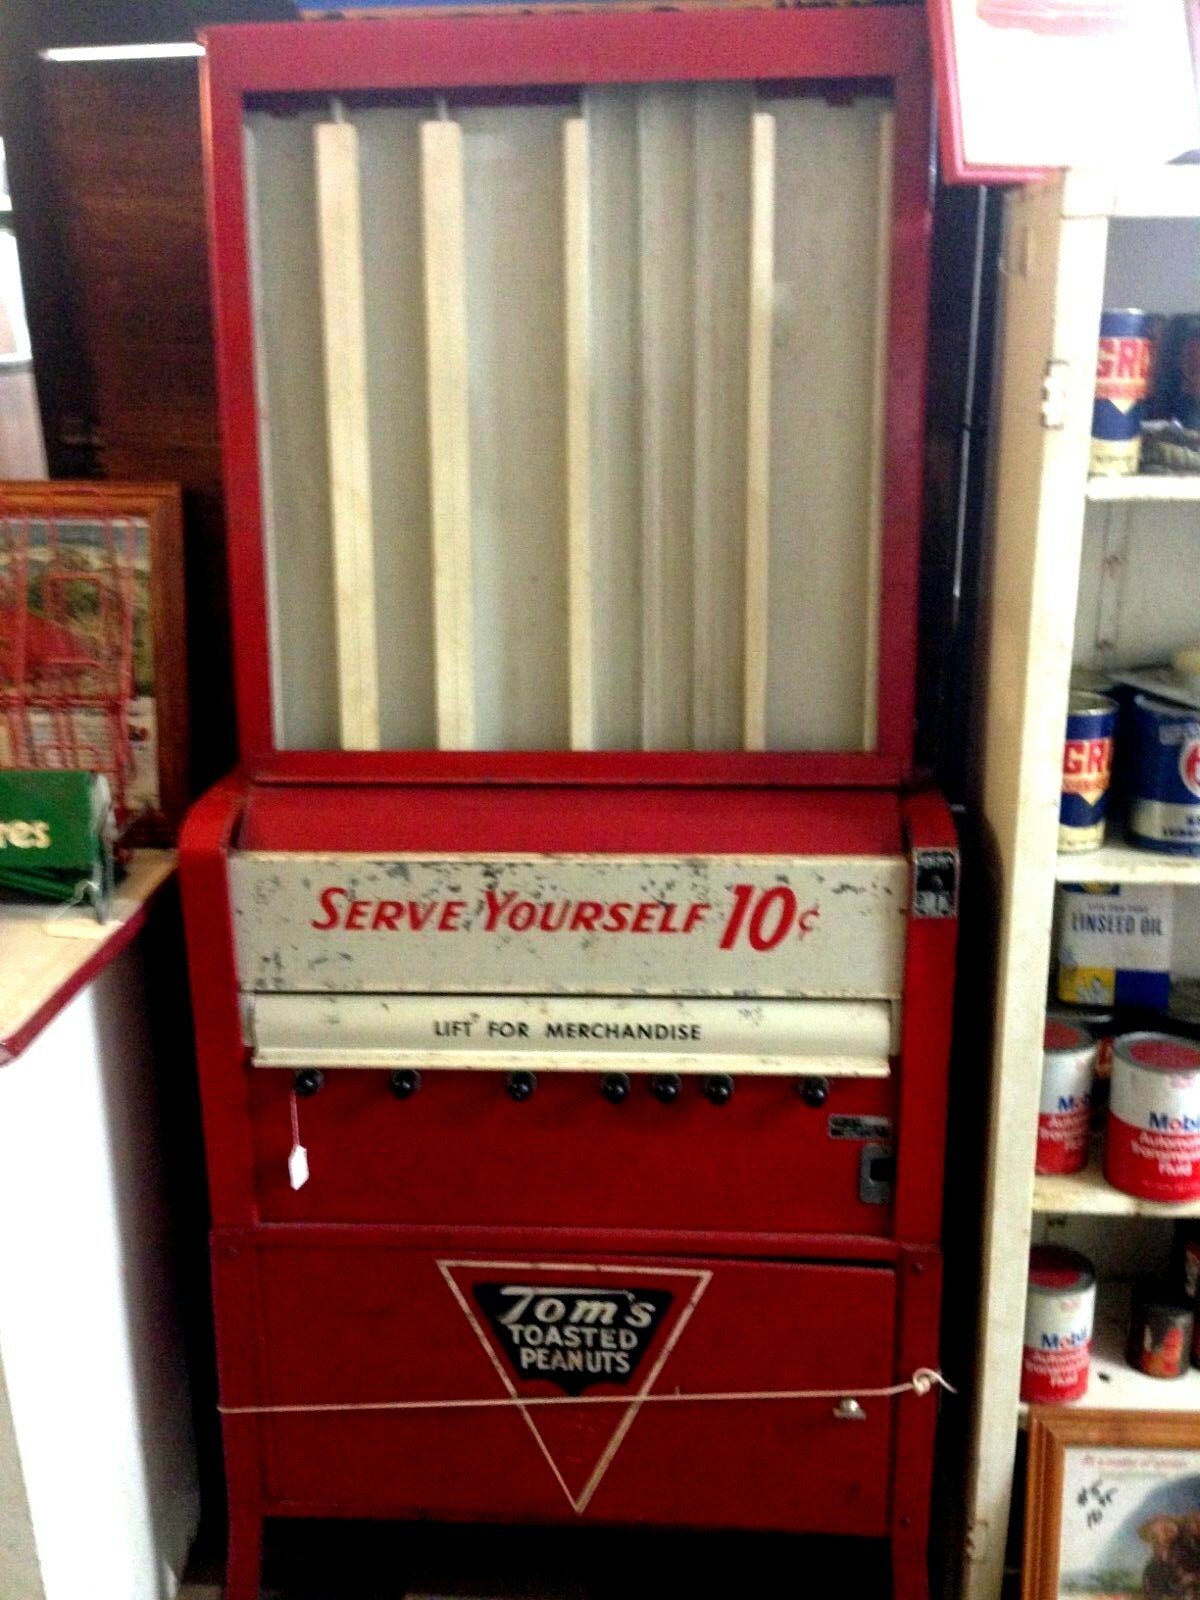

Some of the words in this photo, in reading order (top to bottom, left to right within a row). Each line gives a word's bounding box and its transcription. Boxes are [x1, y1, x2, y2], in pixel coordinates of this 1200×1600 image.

[484, 888, 712, 934] YOURSELF
[1071, 913, 1135, 936] LINSEED
[434, 1021, 472, 1038] LIFT
[487, 1021, 531, 1039] FOR
[545, 1022, 702, 1042] MERCHANDISE
[509, 1324, 638, 1349] TOASTED
[520, 1347, 631, 1373] PEANUTS
